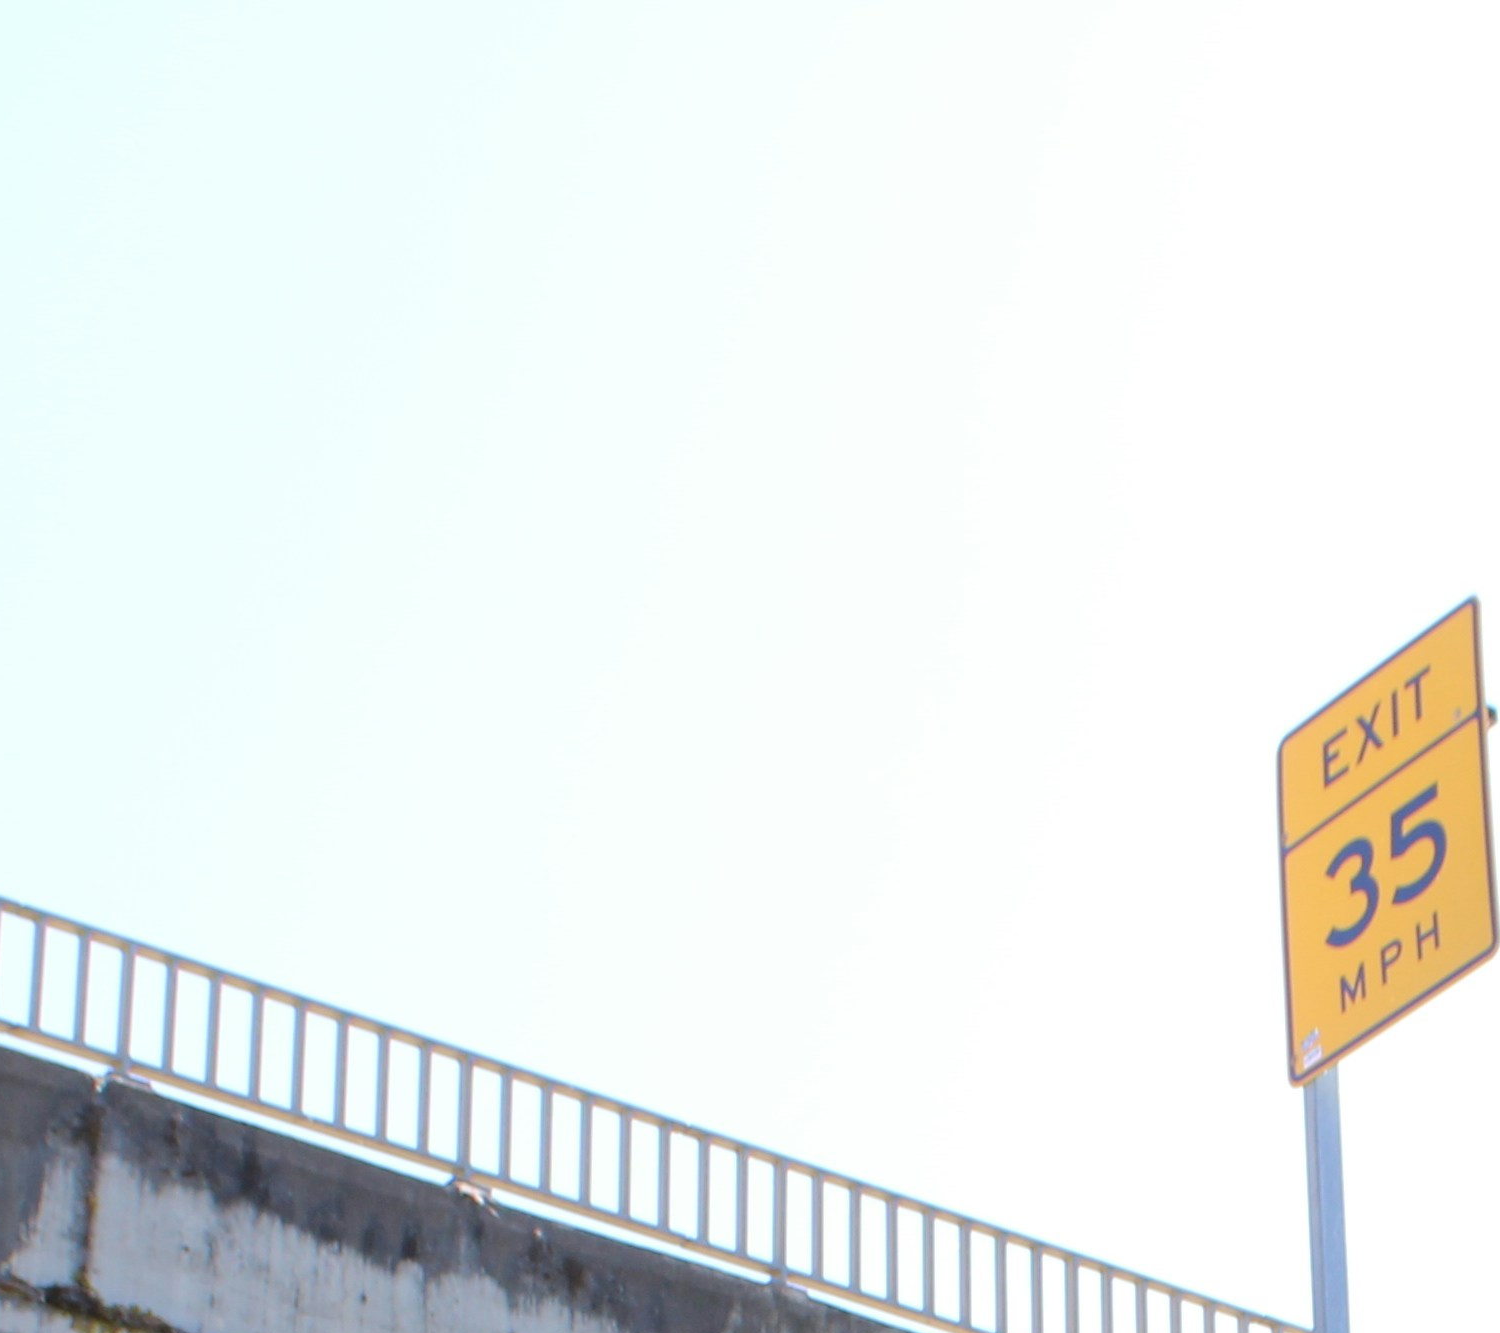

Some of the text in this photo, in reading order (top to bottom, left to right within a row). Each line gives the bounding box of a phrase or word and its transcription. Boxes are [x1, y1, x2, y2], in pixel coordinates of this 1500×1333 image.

[1322, 664, 1431, 789] EXIT
[1324, 781, 1448, 948] 35
[1340, 911, 1441, 1014] MPH
